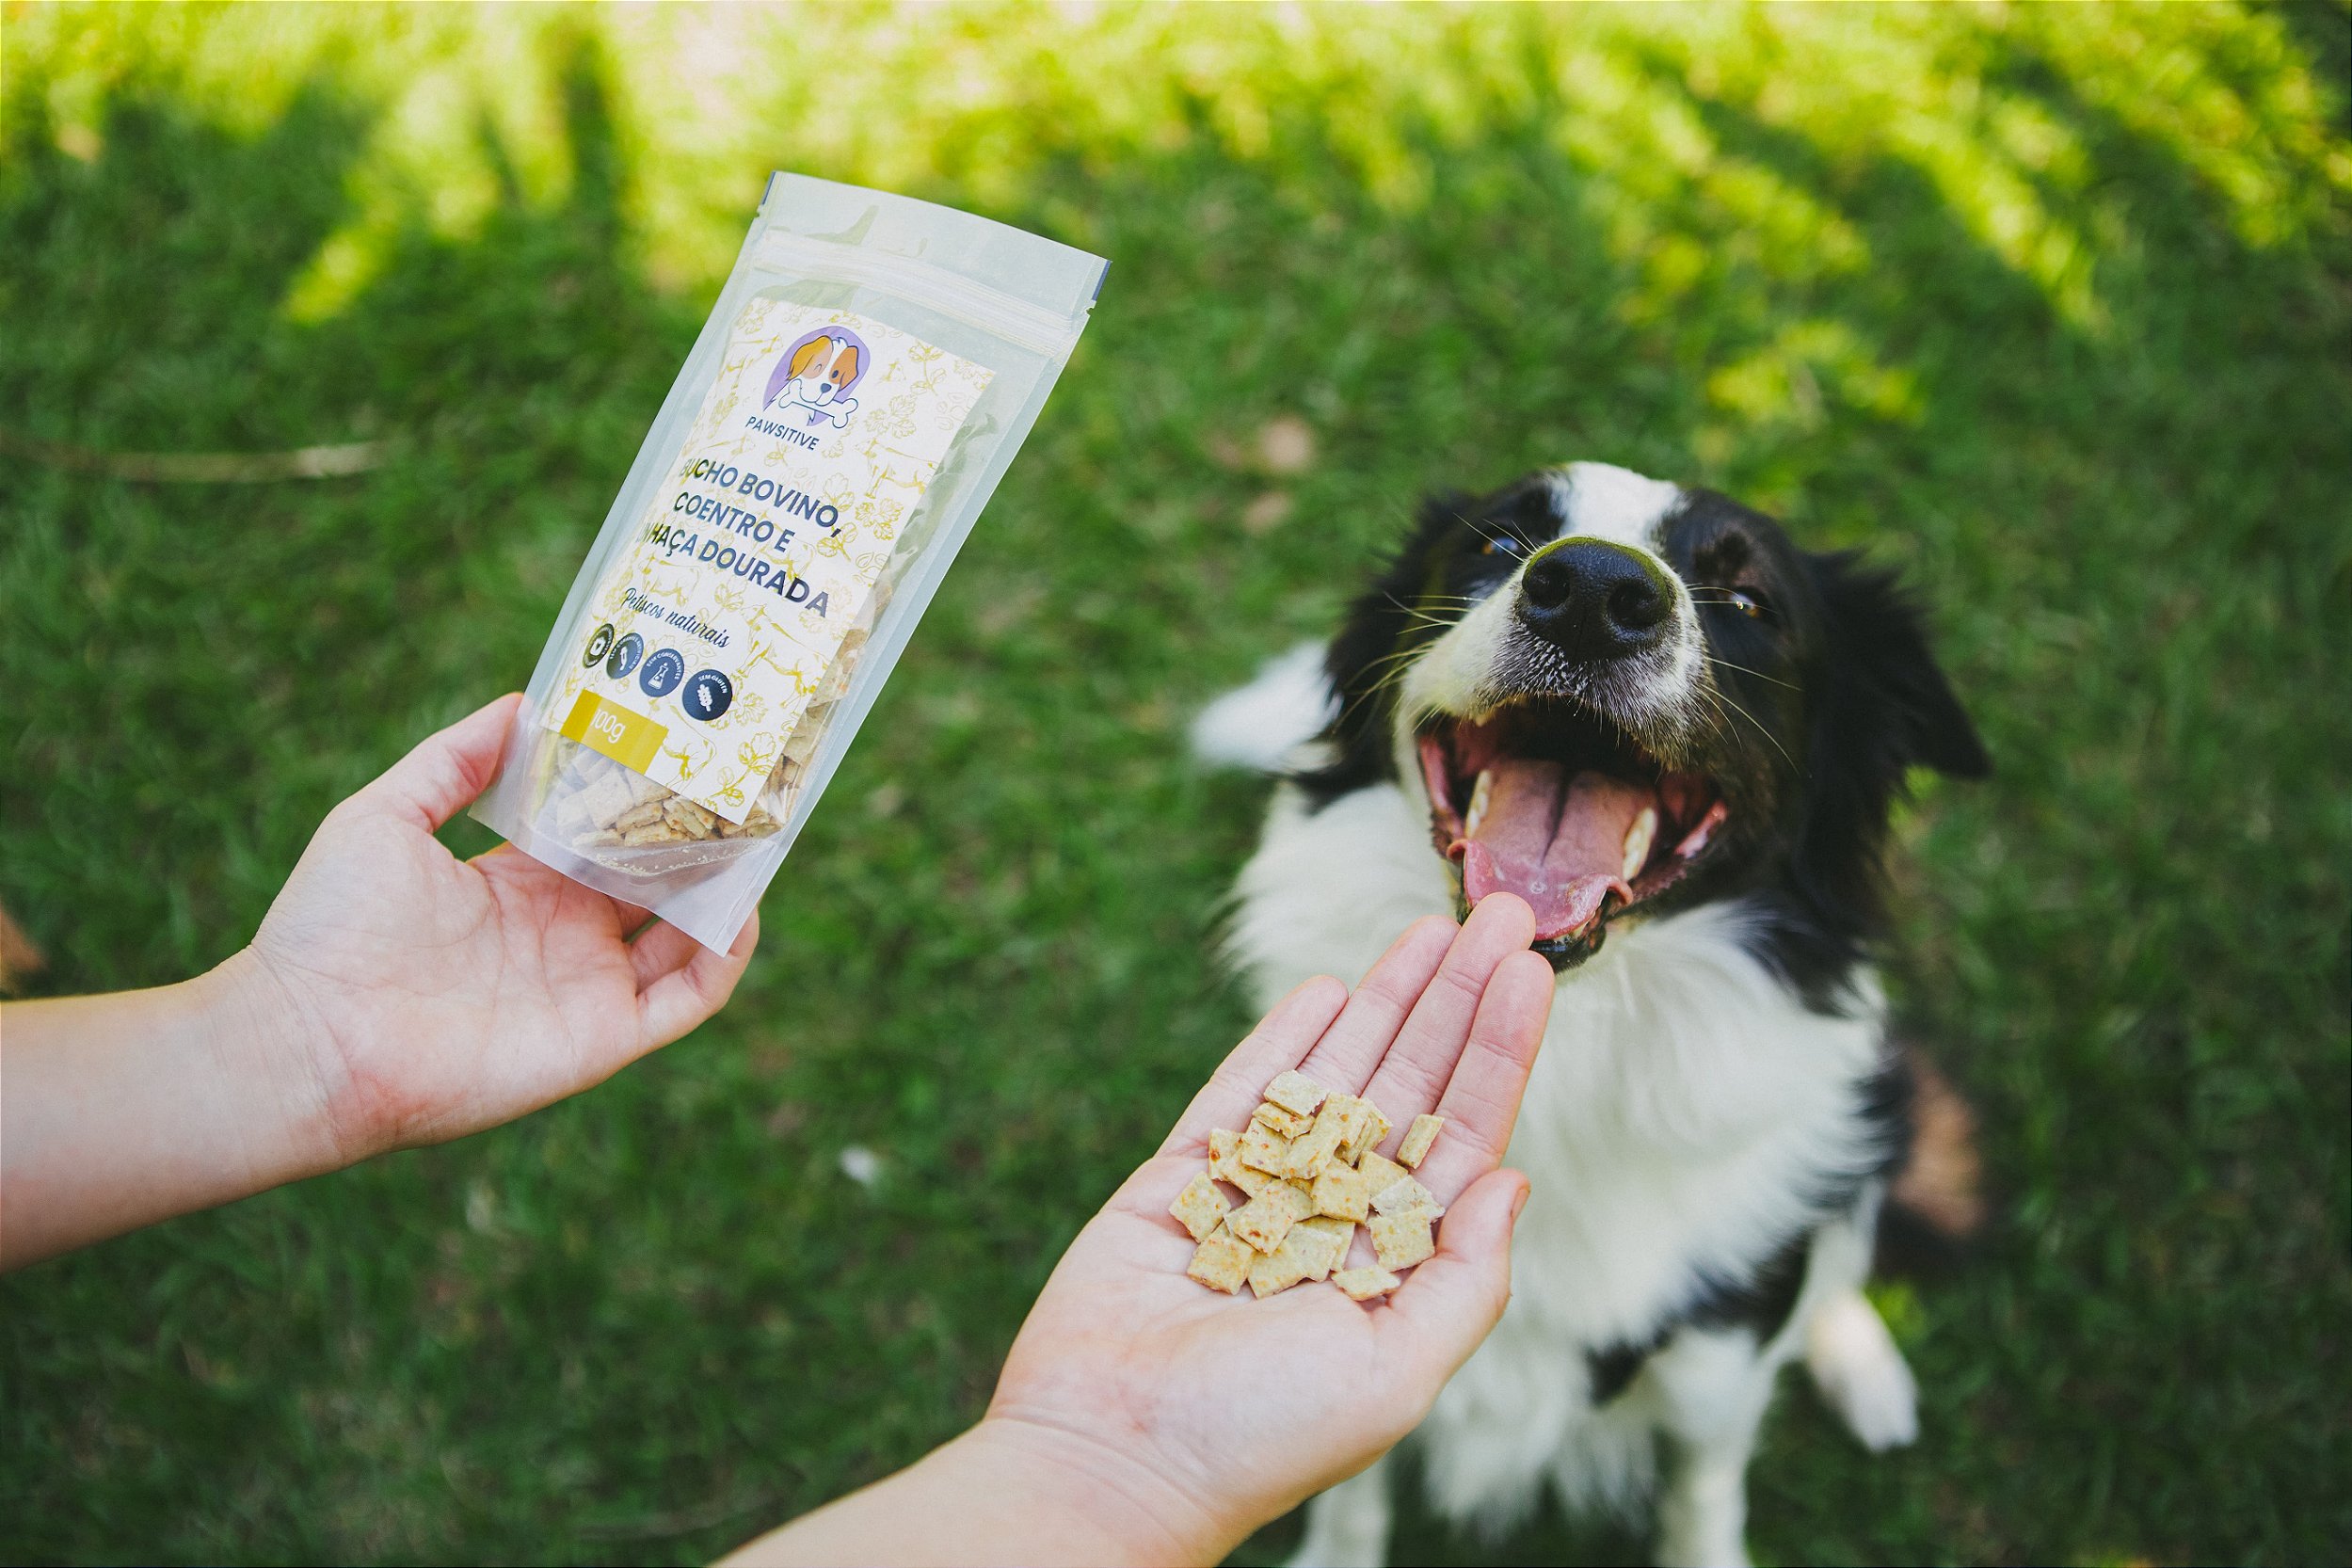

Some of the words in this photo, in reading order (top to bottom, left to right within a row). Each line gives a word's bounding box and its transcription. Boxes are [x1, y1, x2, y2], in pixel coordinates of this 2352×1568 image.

[744, 416, 820, 451] PAWSITIVE
[673, 491, 775, 543] COENTRO
[774, 528, 796, 552] E
[737, 472, 841, 537] BOVINO,
[698, 539, 830, 618] DOURADA
[620, 587, 664, 618] Petiscos
[664, 610, 730, 648] naturais
[711, 675, 728, 694] GLUTEN
[590, 709, 626, 744] 100g
